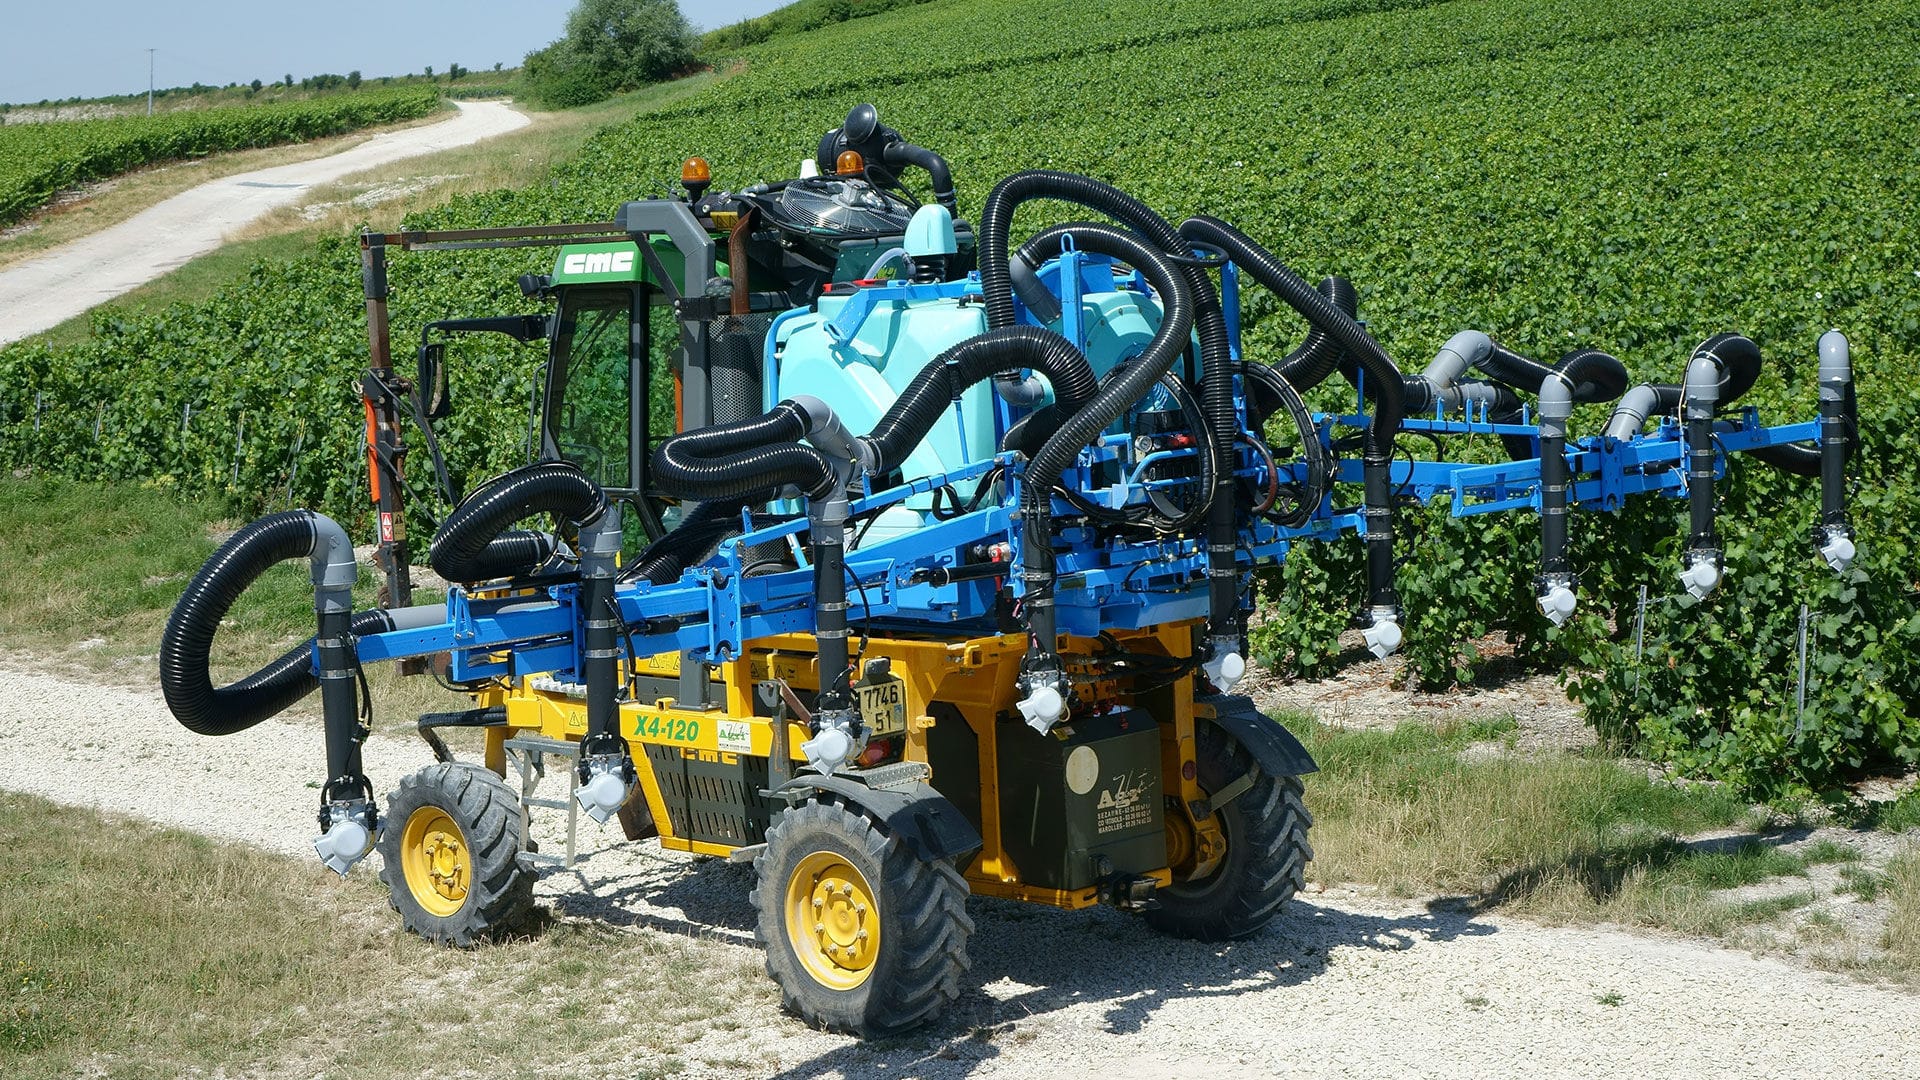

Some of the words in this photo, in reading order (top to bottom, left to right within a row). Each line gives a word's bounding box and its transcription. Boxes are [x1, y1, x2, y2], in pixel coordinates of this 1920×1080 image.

[564, 251, 634, 274] CMC
[864, 685, 898, 709] 7746
[634, 715, 699, 741] X4-120
[875, 710, 891, 731] 51
[680, 747, 737, 765] CMC
